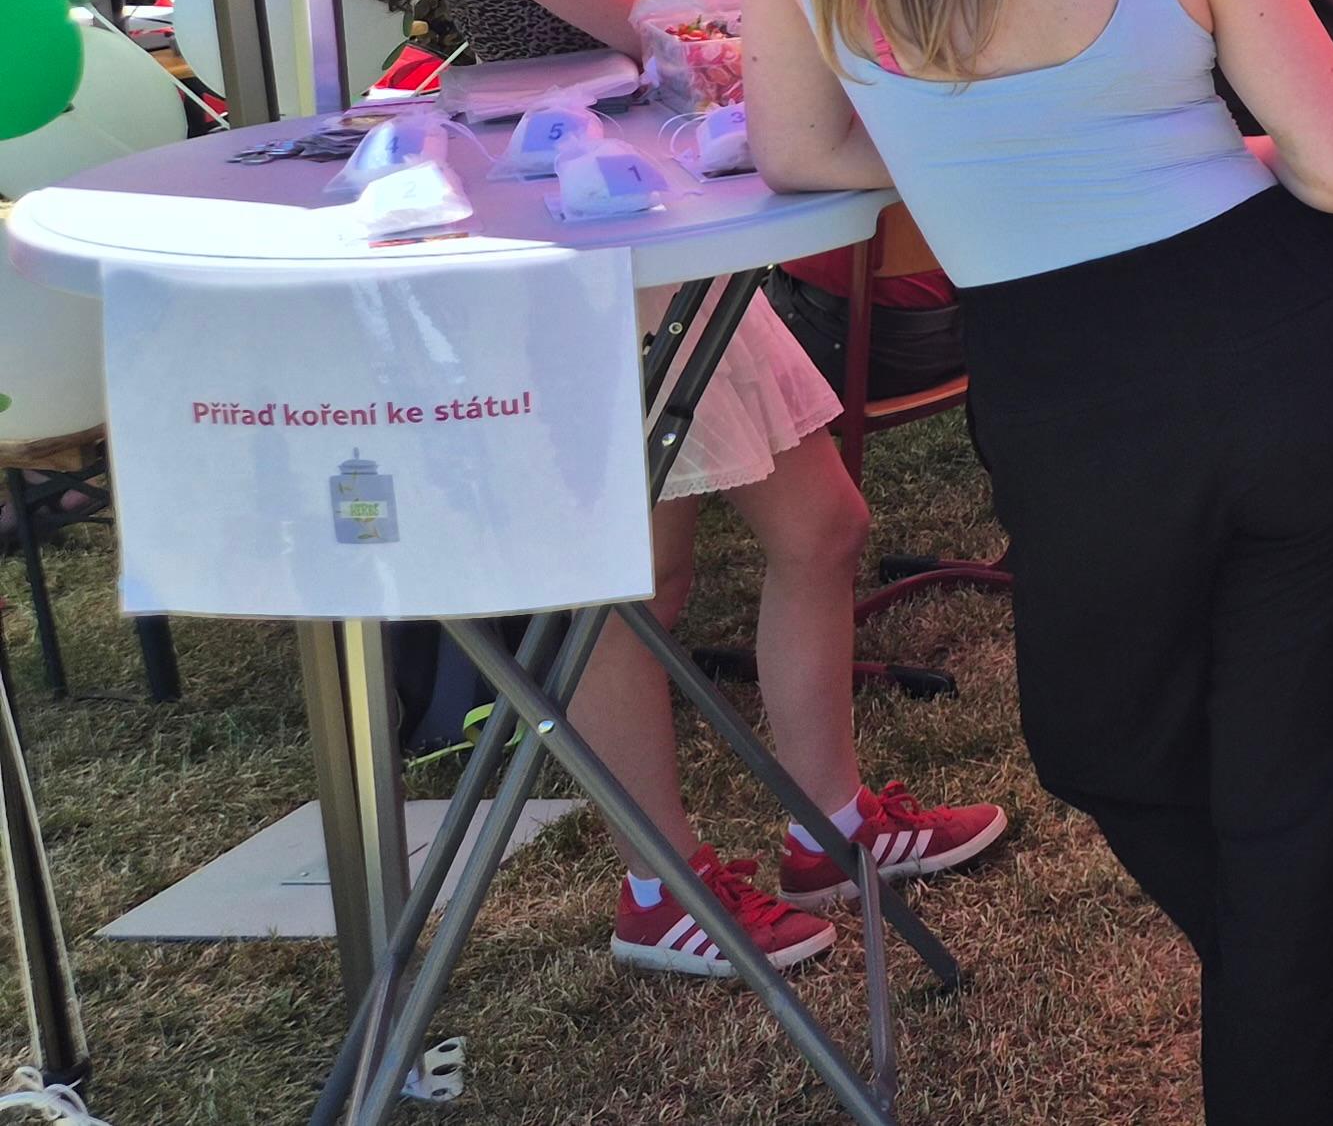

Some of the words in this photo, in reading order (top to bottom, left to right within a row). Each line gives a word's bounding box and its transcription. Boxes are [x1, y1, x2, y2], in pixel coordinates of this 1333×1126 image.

[548, 122, 563, 140] 5
[385, 134, 400, 154] 4
[630, 165, 642, 182] 1
[403, 181, 417, 198] 2
[192, 401, 276, 426] Přiřaď
[283, 403, 377, 426] koření
[386, 401, 424, 424] ke
[434, 391, 532, 422] státu!
